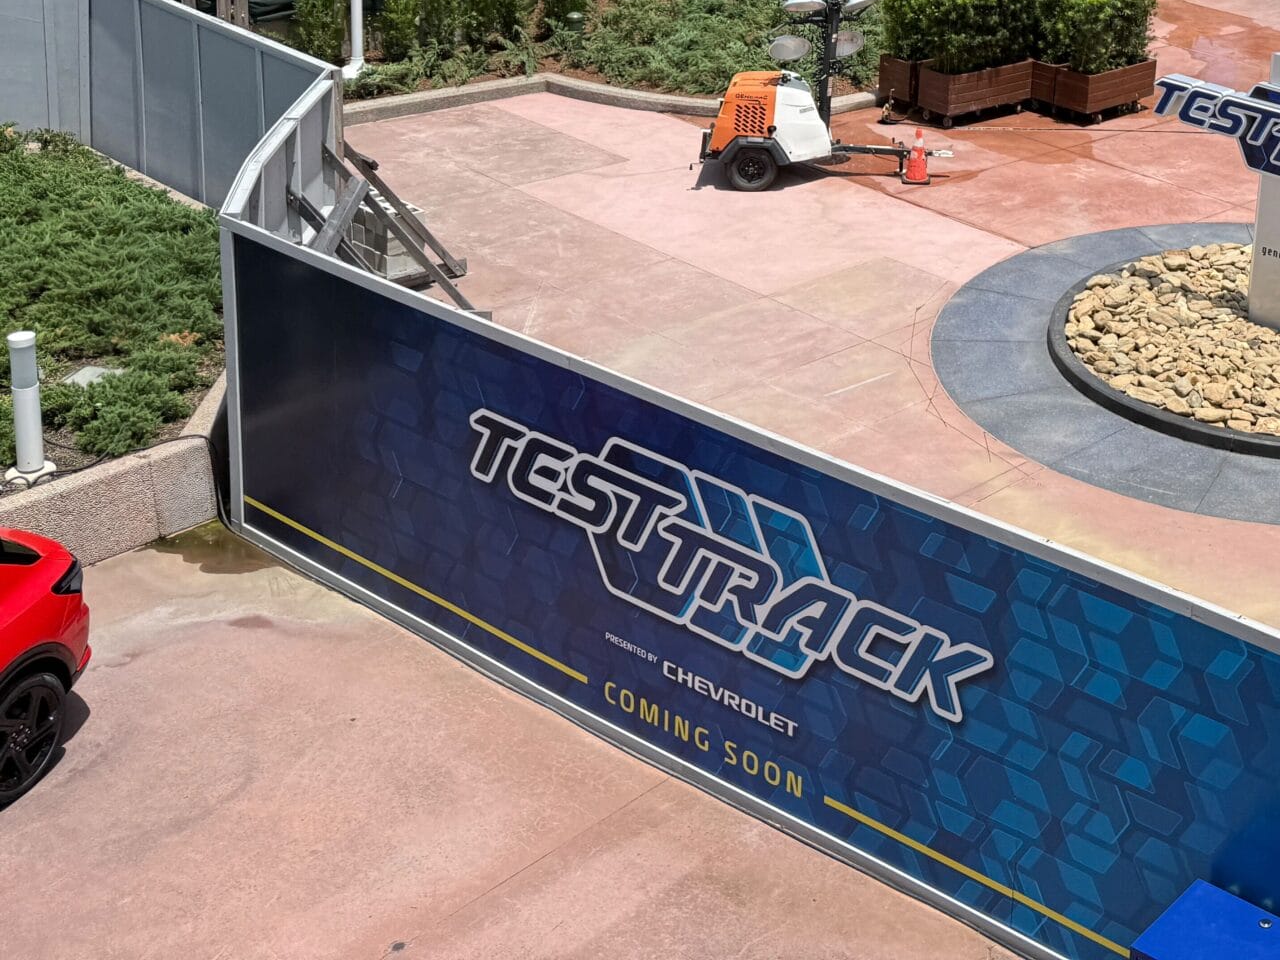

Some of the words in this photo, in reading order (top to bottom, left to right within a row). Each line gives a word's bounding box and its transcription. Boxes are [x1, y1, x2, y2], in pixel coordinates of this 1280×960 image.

[470, 408, 687, 552] TEST
[605, 631, 647, 659] PRESENTED
[647, 652, 658, 663] BY
[662, 660, 799, 737] CHEVROLET
[657, 516, 993, 723] TRACK
[604, 681, 709, 752] COMING
[724, 740, 802, 798] SOON
